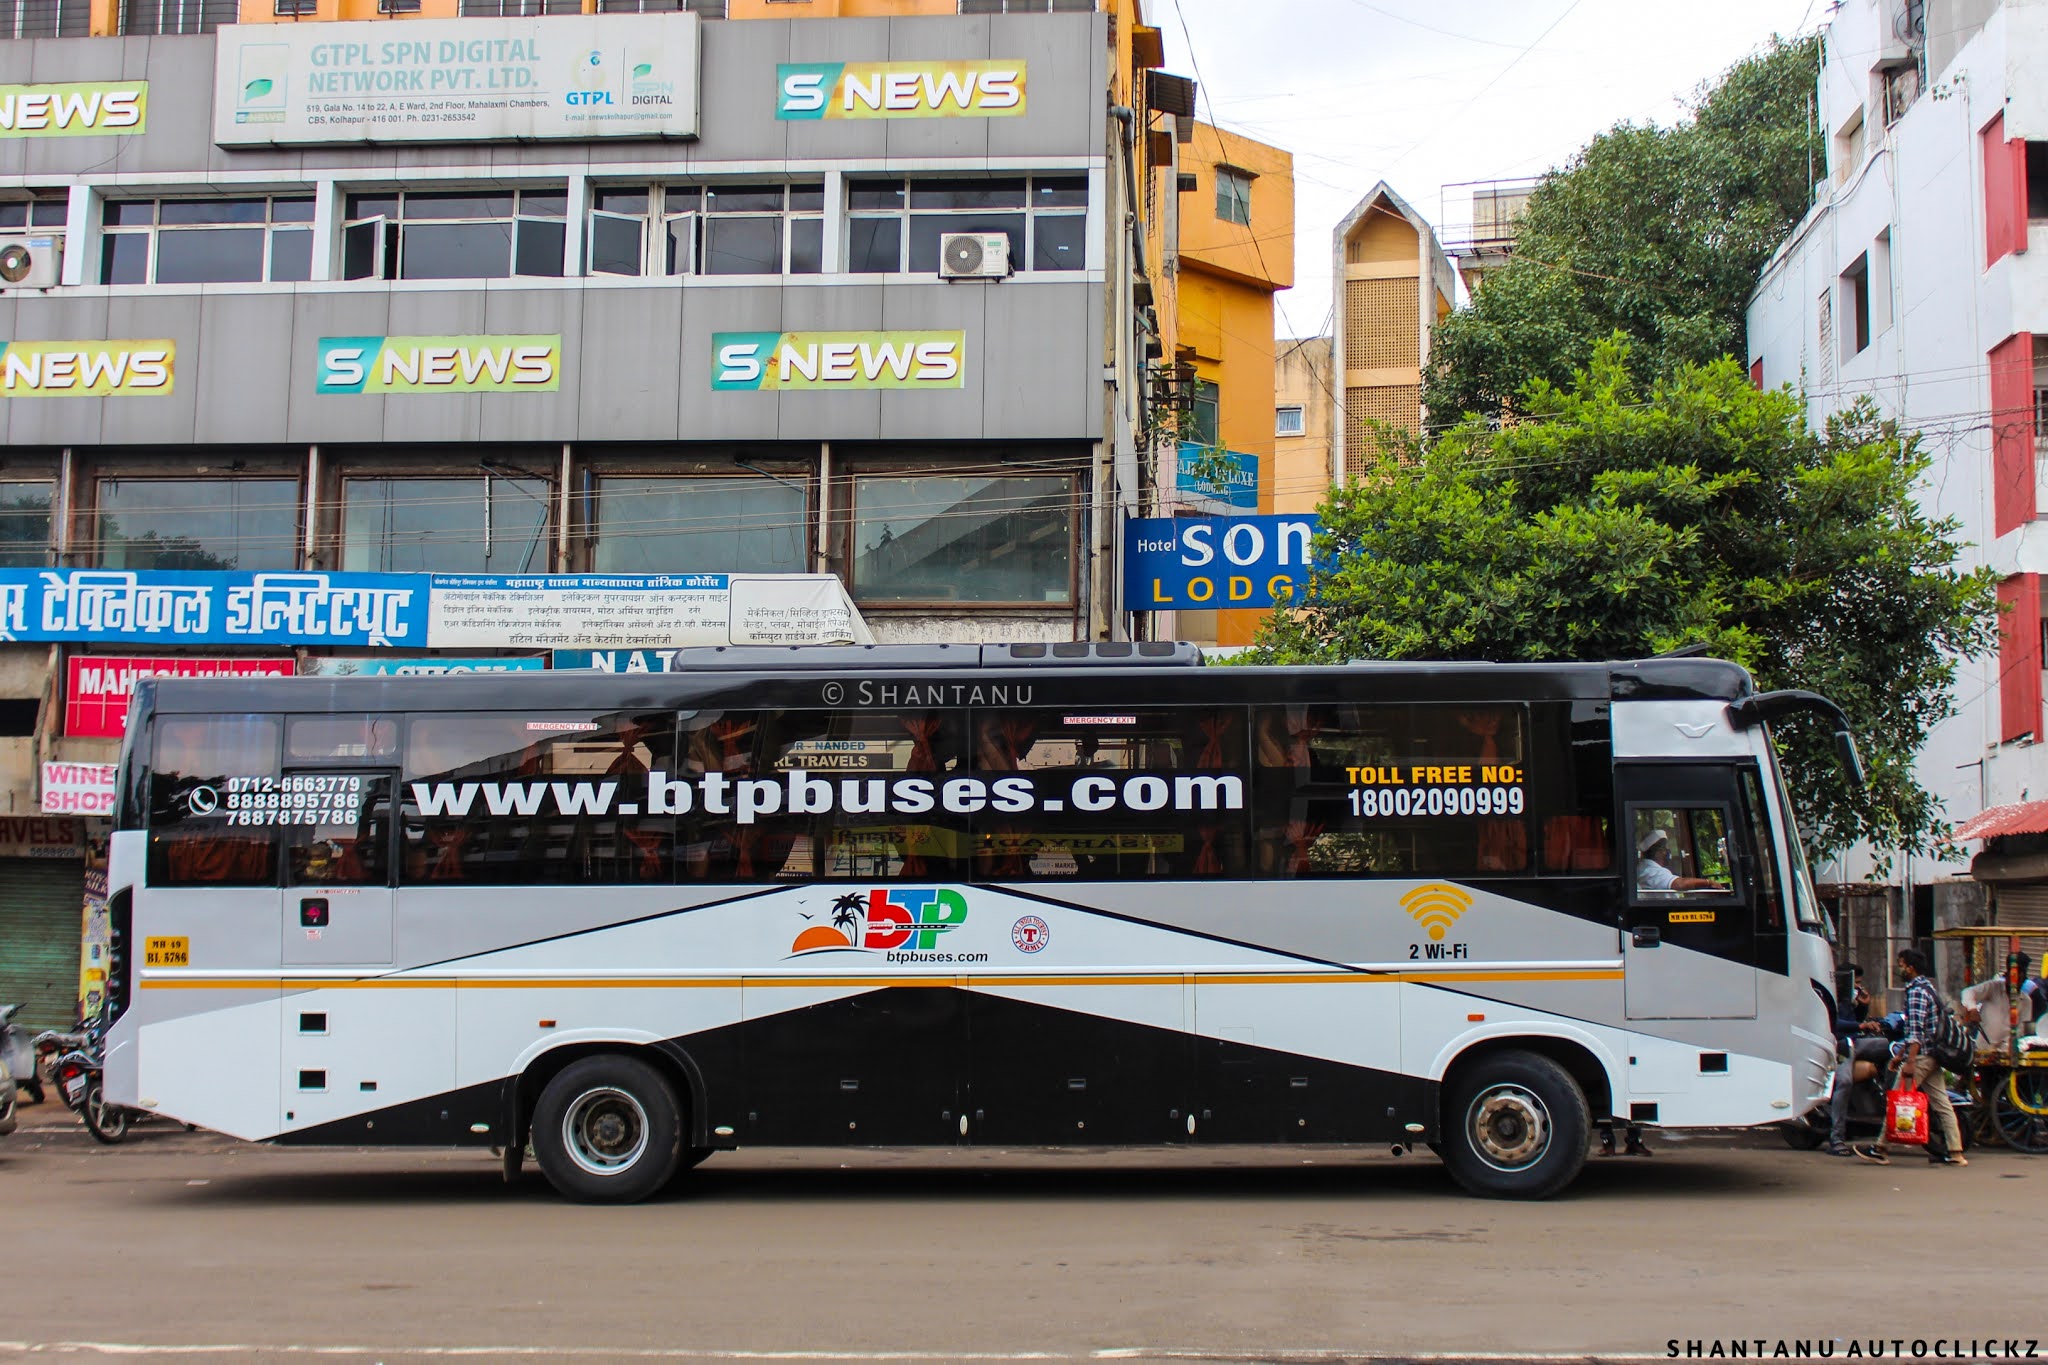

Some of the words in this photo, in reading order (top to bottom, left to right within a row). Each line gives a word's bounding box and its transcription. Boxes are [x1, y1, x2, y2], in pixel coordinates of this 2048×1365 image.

[310, 43, 374, 67] GTPL
[381, 41, 431, 65] SPN
[439, 39, 541, 64] DIGITAL
[308, 69, 424, 93] NETWORK
[431, 68, 481, 90] PVT.
[488, 67, 538, 89] LTD.
[566, 91, 614, 106] GTPL
[783, 74, 824, 111] S
[844, 71, 1020, 110] NEWS
[306, 103, 322, 113] 519,
[323, 103, 341, 112] Gala
[342, 104, 354, 112] No.
[377, 103, 388, 112] 22,
[399, 102, 404, 110] E
[405, 102, 427, 111] Ward,
[429, 102, 443, 110] 2nd
[445, 101, 466, 110] Floor,
[468, 99, 508, 109] Mahalaxmi
[509, 98, 550, 109] Chambers,
[632, 95, 673, 105] DIGITAL
[308, 116, 328, 125] CBS,
[330, 115, 365, 125] Kolhapur
[372, 115, 387, 123] 416
[406, 114, 419, 122] Ph.
[421, 113, 476, 122] 0231-2653542
[565, 113, 585, 121] E-mail:
[324, 348, 364, 385] S
[382, 345, 552, 384] NEWS
[719, 344, 761, 381] S
[780, 342, 958, 381] NEWS
[5, 351, 167, 388] NEWS
[1215, 466, 1254, 487] DLUXE
[1194, 480, 1232, 496] (LODGG)
[1138, 539, 1176, 554] Hotel
[506, 578, 545, 589] महाराष्ट्र
[548, 579, 579, 587] शासन
[581, 578, 644, 587] मान्यताप्राप्त
[647, 577, 683, 587] तांत्रिक
[39, 571, 213, 633] टेक्निकल
[597, 605, 615, 614] मोटर
[509, 633, 533, 644] हॉटेल
[815, 741, 866, 750] NANDED
[798, 755, 868, 767] TRAVELS
[47, 766, 114, 785] WINE
[1346, 767, 1404, 784] TOLL
[1411, 766, 1472, 784] FREE
[1482, 766, 1523, 783] NO:
[228, 777, 360, 793] 0712-6663779
[45, 791, 115, 810] SHOP
[227, 793, 360, 809] 8888895786
[411, 769, 1243, 824] www.btpbuses.com
[1347, 786, 1524, 817] 18002090999
[225, 810, 358, 827] 7887875786
[1023, 928, 1037, 942] T
[152, 940, 166, 948] MH
[1015, 939, 1044, 951] PERMIT
[1409, 944, 1419, 959] 2
[1425, 944, 1468, 959] Wi-Fi
[147, 952, 160, 963] BL
[164, 952, 187, 963] 5786
[886, 950, 988, 965] btpbuses.com
